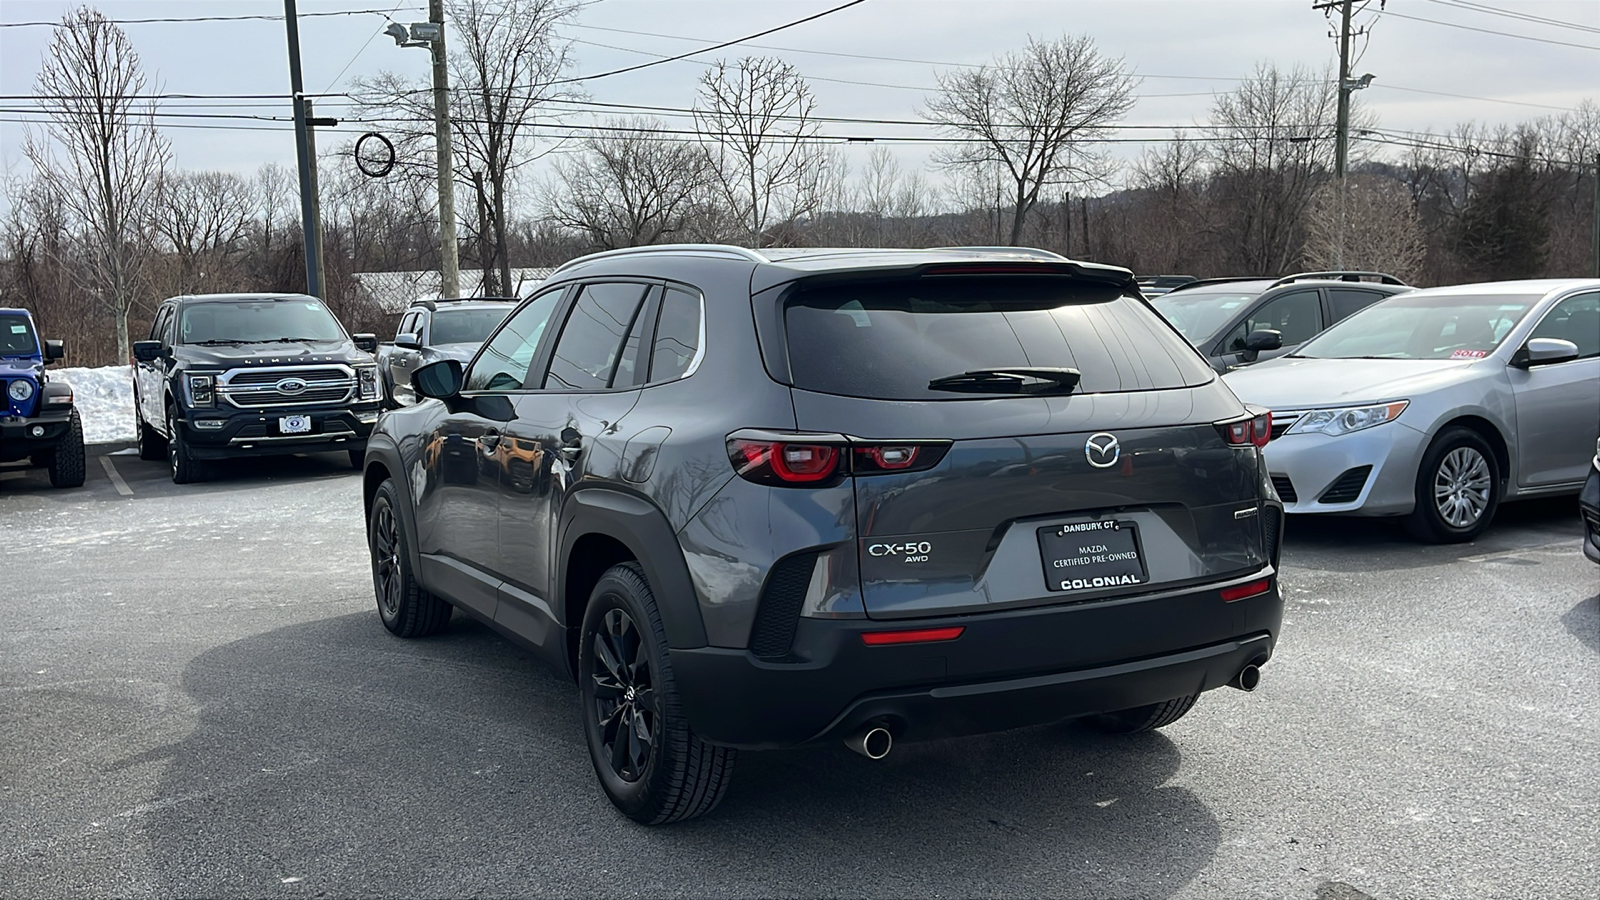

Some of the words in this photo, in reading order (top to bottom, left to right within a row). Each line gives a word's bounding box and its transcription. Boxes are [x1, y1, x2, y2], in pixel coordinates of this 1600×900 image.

[1453, 350, 1485, 358] SOLD
[245, 356, 332, 364] LIMITED
[1104, 520, 1114, 529] CT
[868, 541, 932, 556] CX-50
[1078, 544, 1108, 554] MAZDA
[904, 555, 929, 563] AWD
[1053, 556, 1090, 568] CERTIFIED
[1092, 551, 1137, 564] PRE-OWNED
[1061, 574, 1140, 590] COLONIAL
